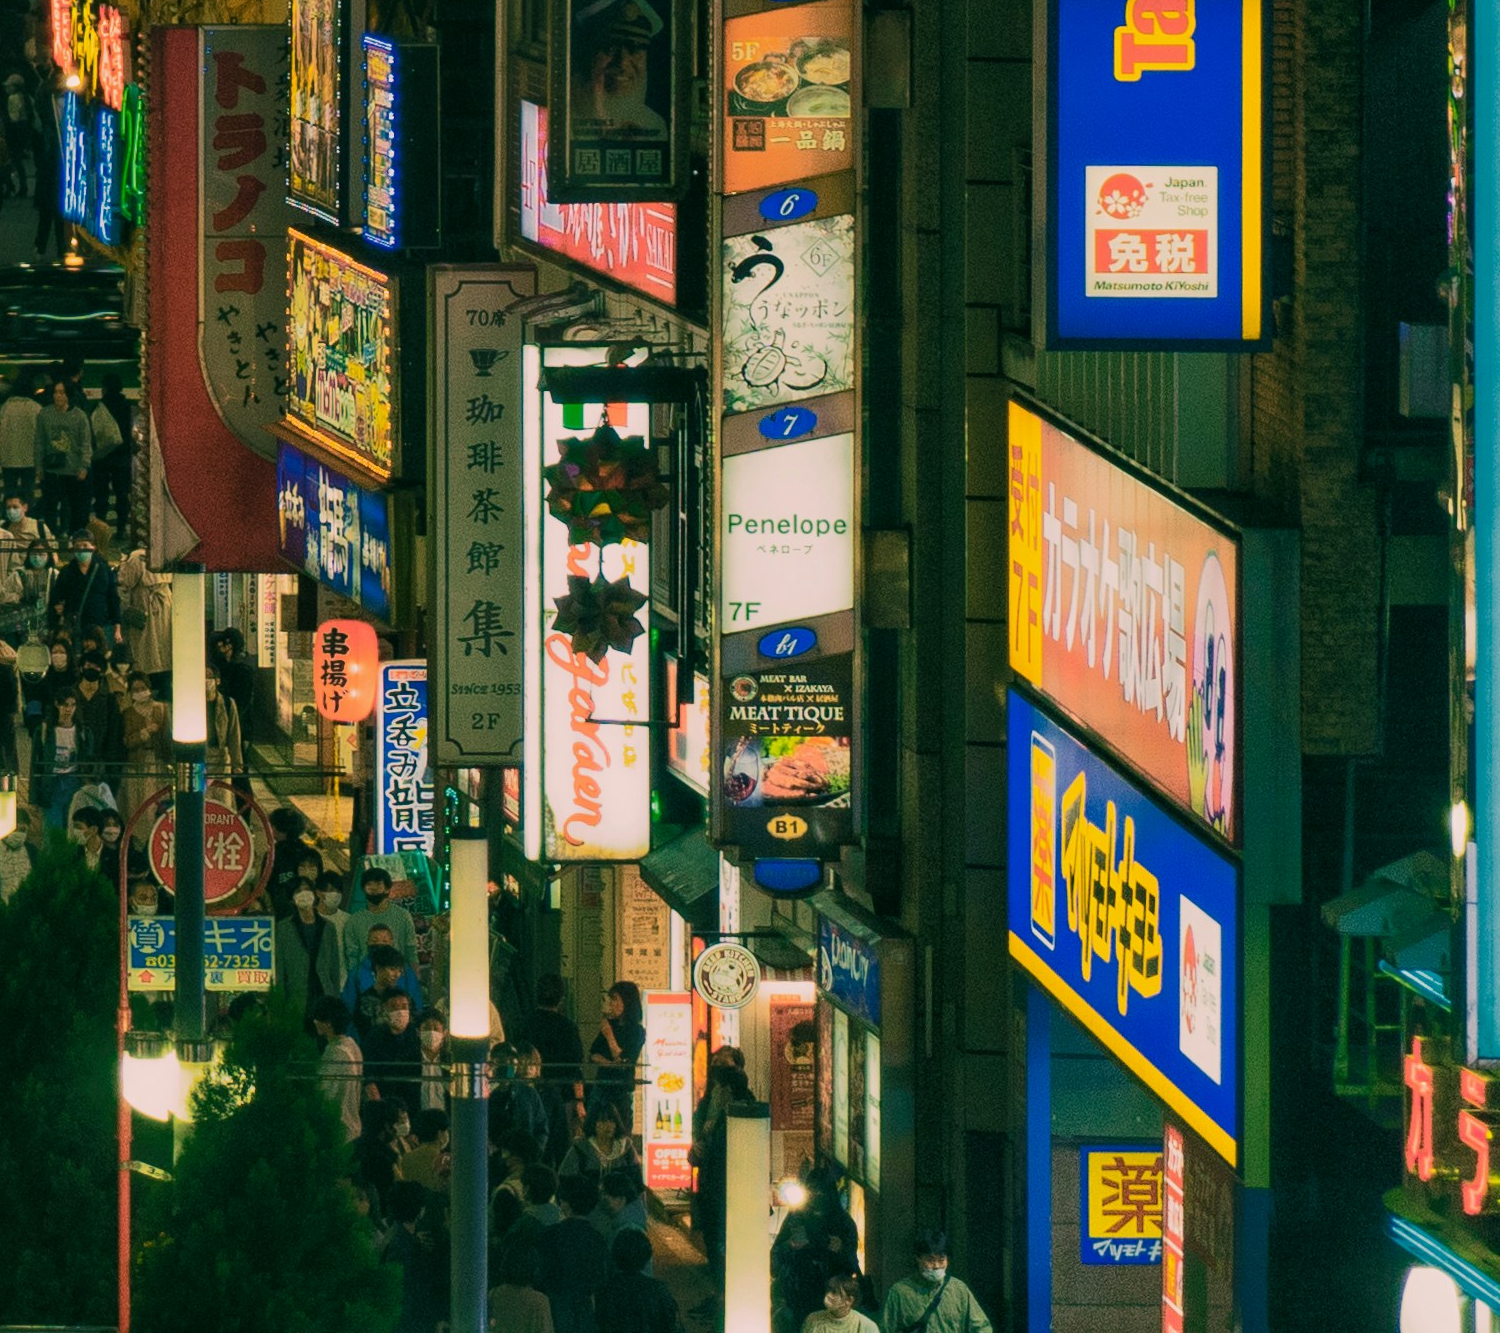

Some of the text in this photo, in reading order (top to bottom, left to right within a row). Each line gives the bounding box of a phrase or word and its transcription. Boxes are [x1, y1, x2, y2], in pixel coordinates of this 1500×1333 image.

[731, 41, 760, 62] 5F
[770, 128, 847, 153] 一品鍋
[575, 147, 663, 175] 居酒屋
[211, 50, 267, 294] トラノコ
[1159, 191, 1209, 203] Tax-free
[1176, 205, 1209, 220] Shop
[1107, 231, 1196, 273] 免税
[1094, 280, 1164, 293] Matsumoto
[216, 304, 261, 407] やきとん
[726, 513, 848, 538] Penelope
[755, 543, 814, 557] ペネロープ
[728, 601, 761, 622] 7F
[1042, 481, 1187, 745] カラオケ歌広場
[321, 627, 350, 714] 串揚げ
[759, 674, 808, 684] MEAT BAR
[794, 684, 835, 694] IZAKAYA
[472, 712, 500, 731] 2F
[729, 705, 845, 724] MEAT TIQUE
[749, 722, 826, 735] ミートティーク
[775, 820, 799, 834] B1
